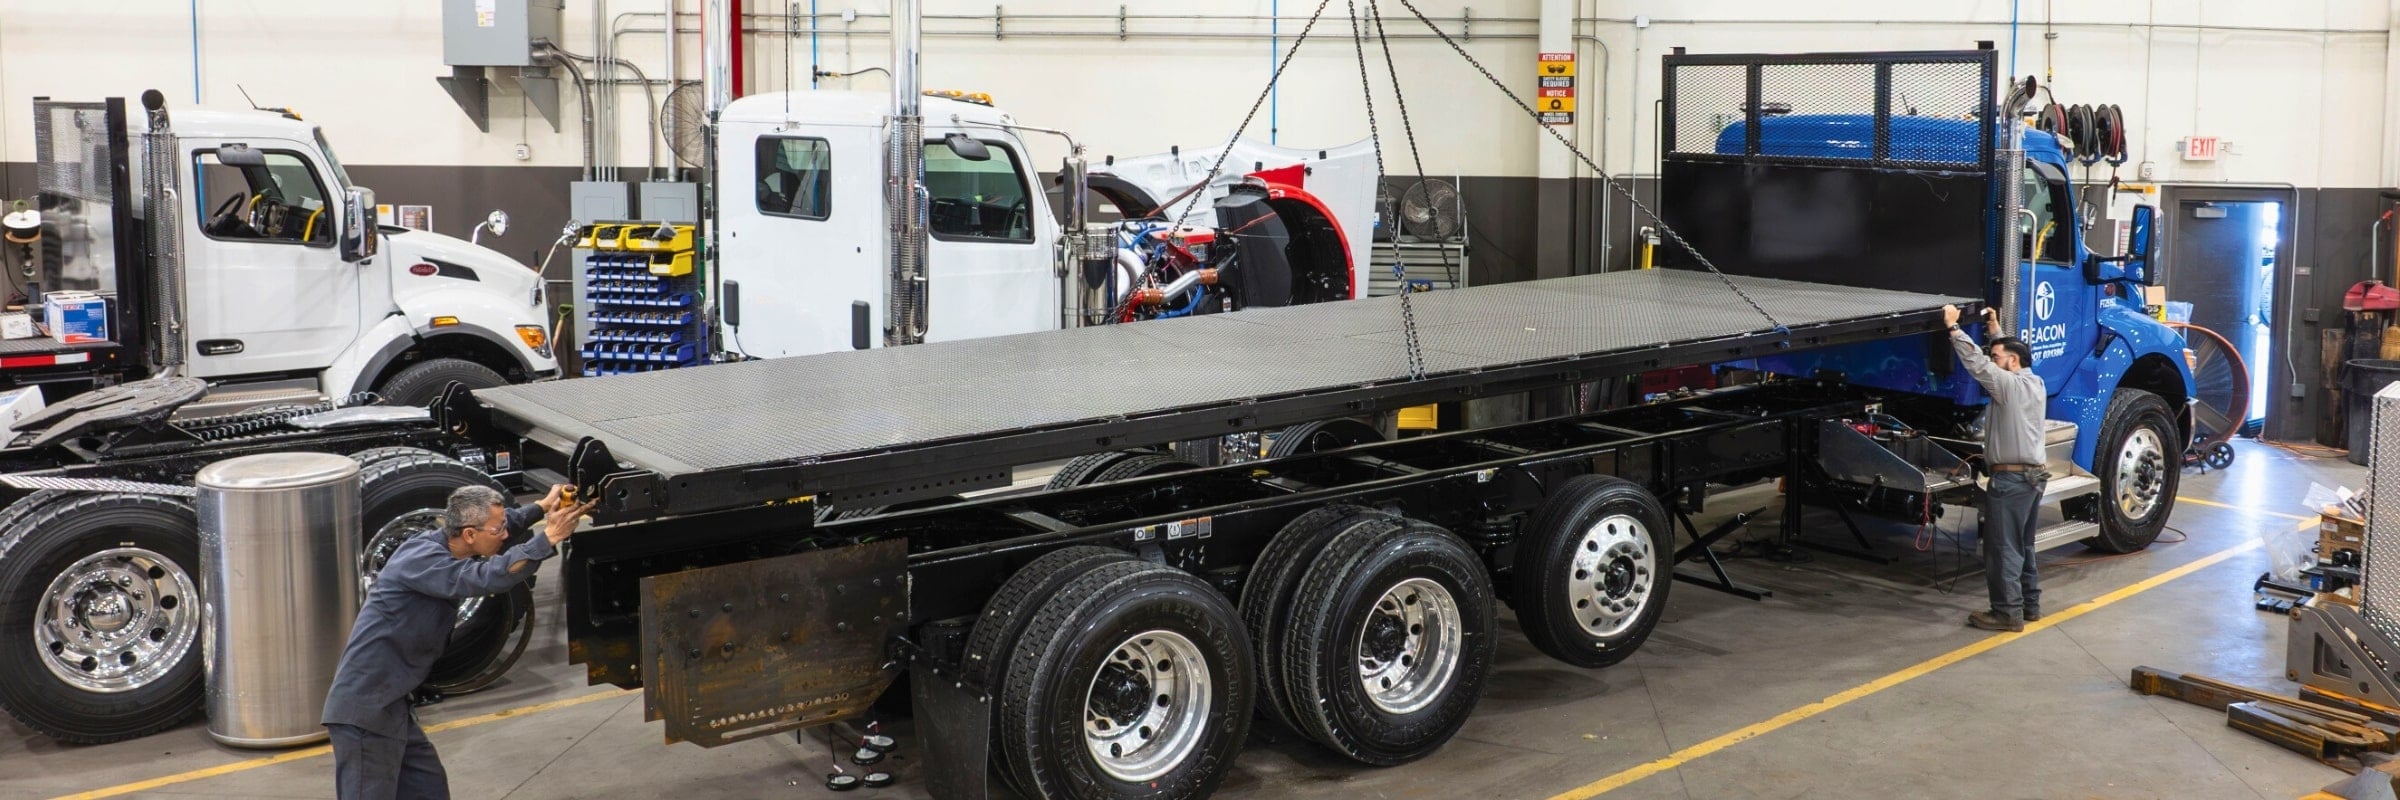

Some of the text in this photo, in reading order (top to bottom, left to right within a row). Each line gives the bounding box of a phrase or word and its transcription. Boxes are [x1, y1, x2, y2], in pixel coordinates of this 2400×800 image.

[1546, 89, 1567, 97] NOTICE
[2191, 138, 2217, 157] EXIT
[2021, 323, 2066, 344] BEACON
